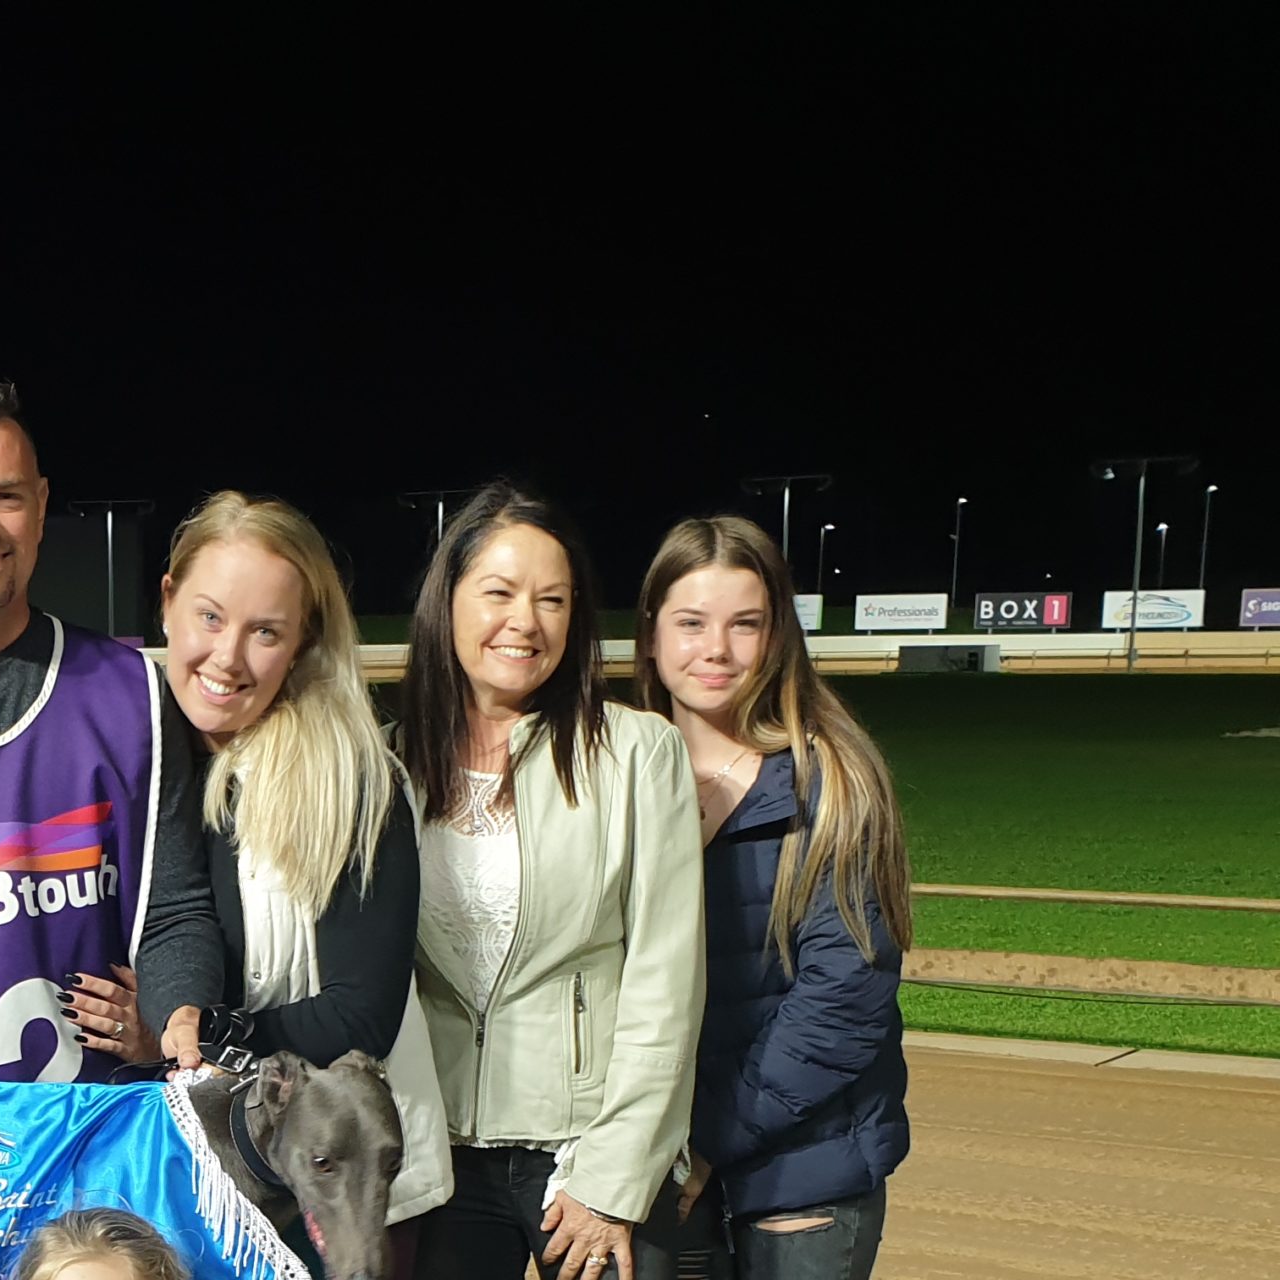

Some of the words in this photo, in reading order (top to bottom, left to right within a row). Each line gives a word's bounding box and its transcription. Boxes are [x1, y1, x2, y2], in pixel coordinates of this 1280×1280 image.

[877, 606, 939, 617] Professionals
[979, 599, 1038, 619] BOX
[1051, 599, 1060, 620] 1
